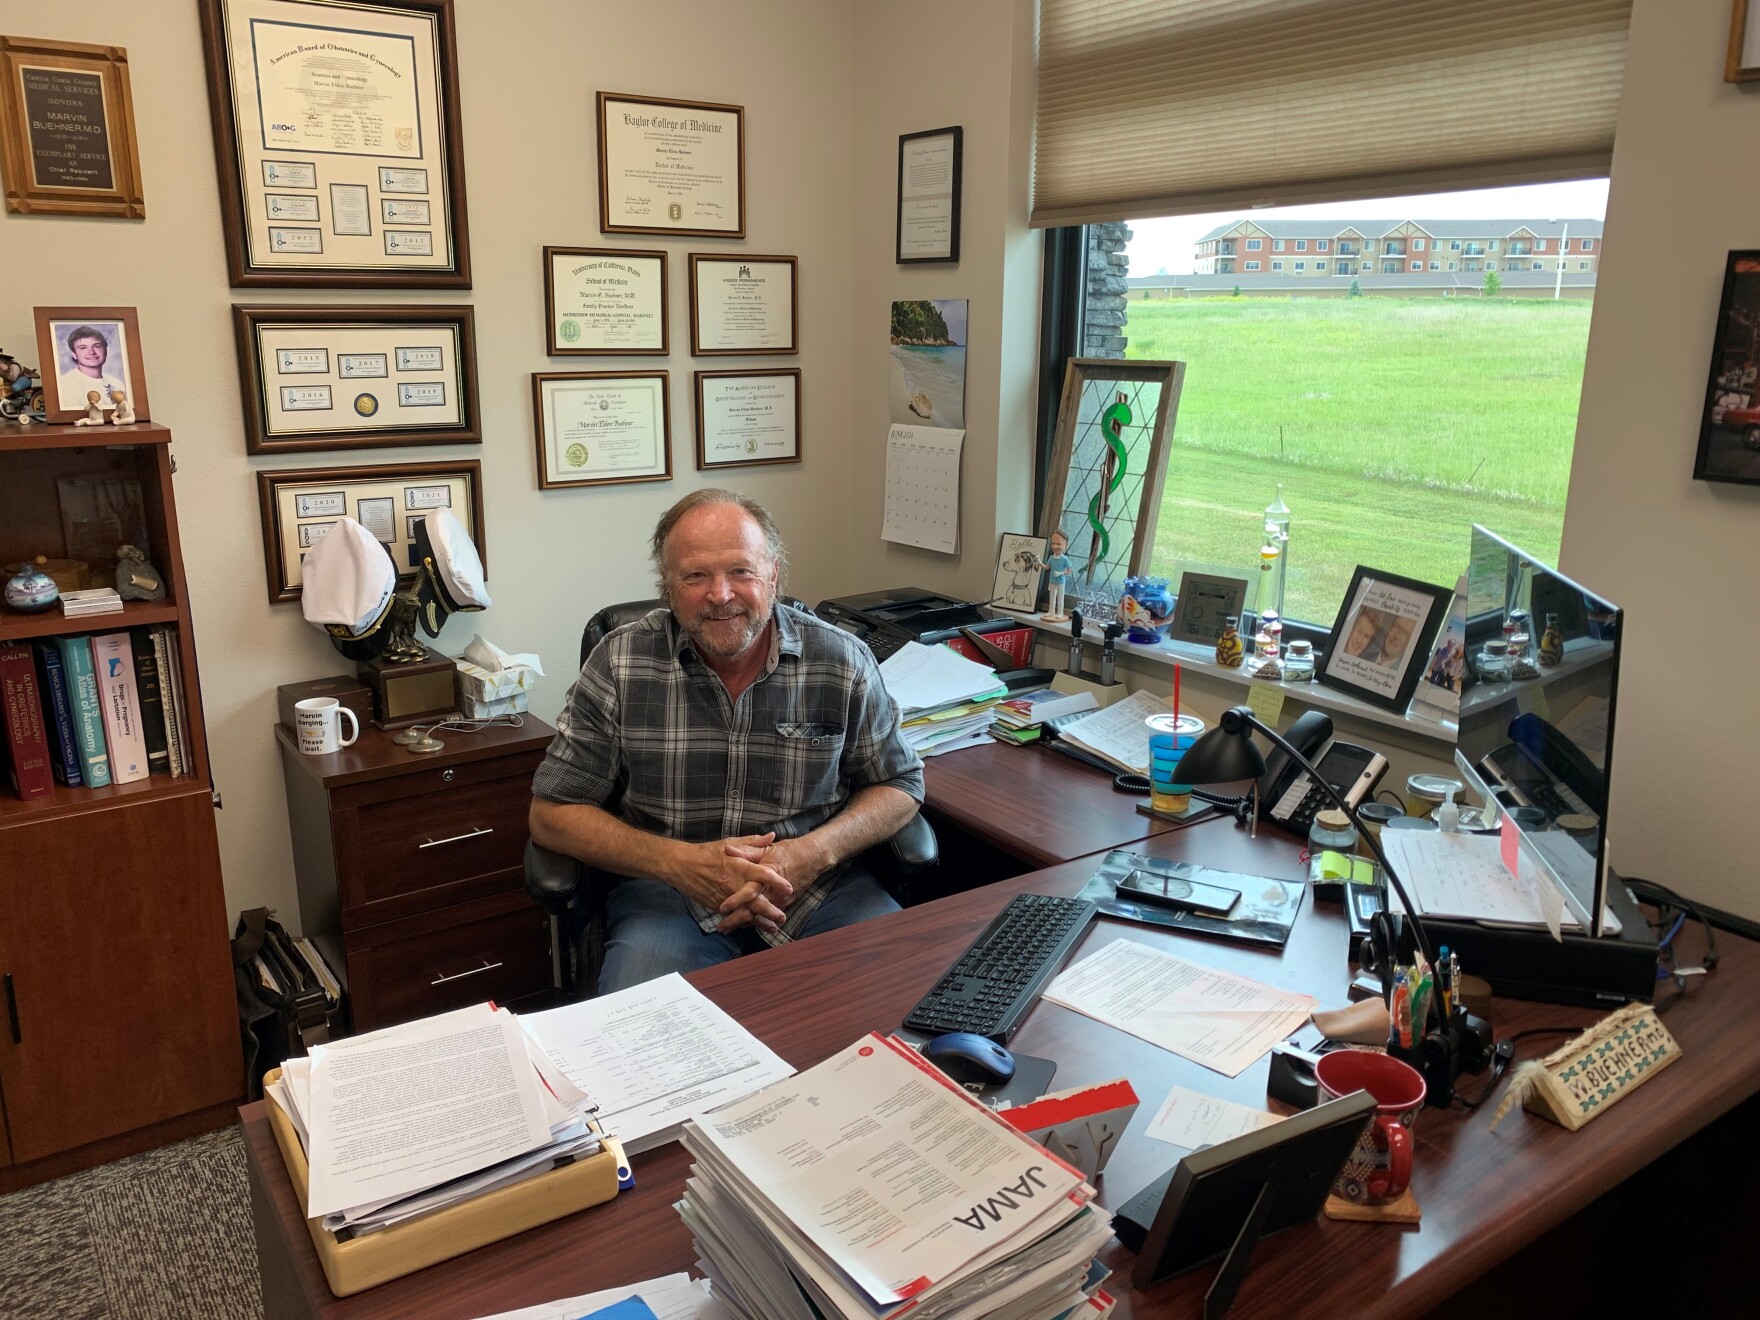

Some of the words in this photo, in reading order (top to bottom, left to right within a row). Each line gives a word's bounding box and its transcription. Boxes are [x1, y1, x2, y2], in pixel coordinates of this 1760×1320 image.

[47, 111, 87, 122] MARVIN
[651, 116, 678, 132] College
[680, 121, 688, 131] of
[690, 119, 722, 134] Medicine
[2, 652, 28, 662] CALLEN
[77, 676, 87, 698] Atlas
[16, 693, 29, 736] OBSTETRICS
[23, 673, 41, 743] ULTRASONOGRAPHY
[81, 700, 89, 710] of
[112, 694, 120, 720] Lactation
[10, 696, 23, 744] GYNECOLOGY
[84, 712, 96, 752] Anatomy
[122, 706, 131, 736] Pregnancy
[953, 1166, 1048, 1232] JAMA
